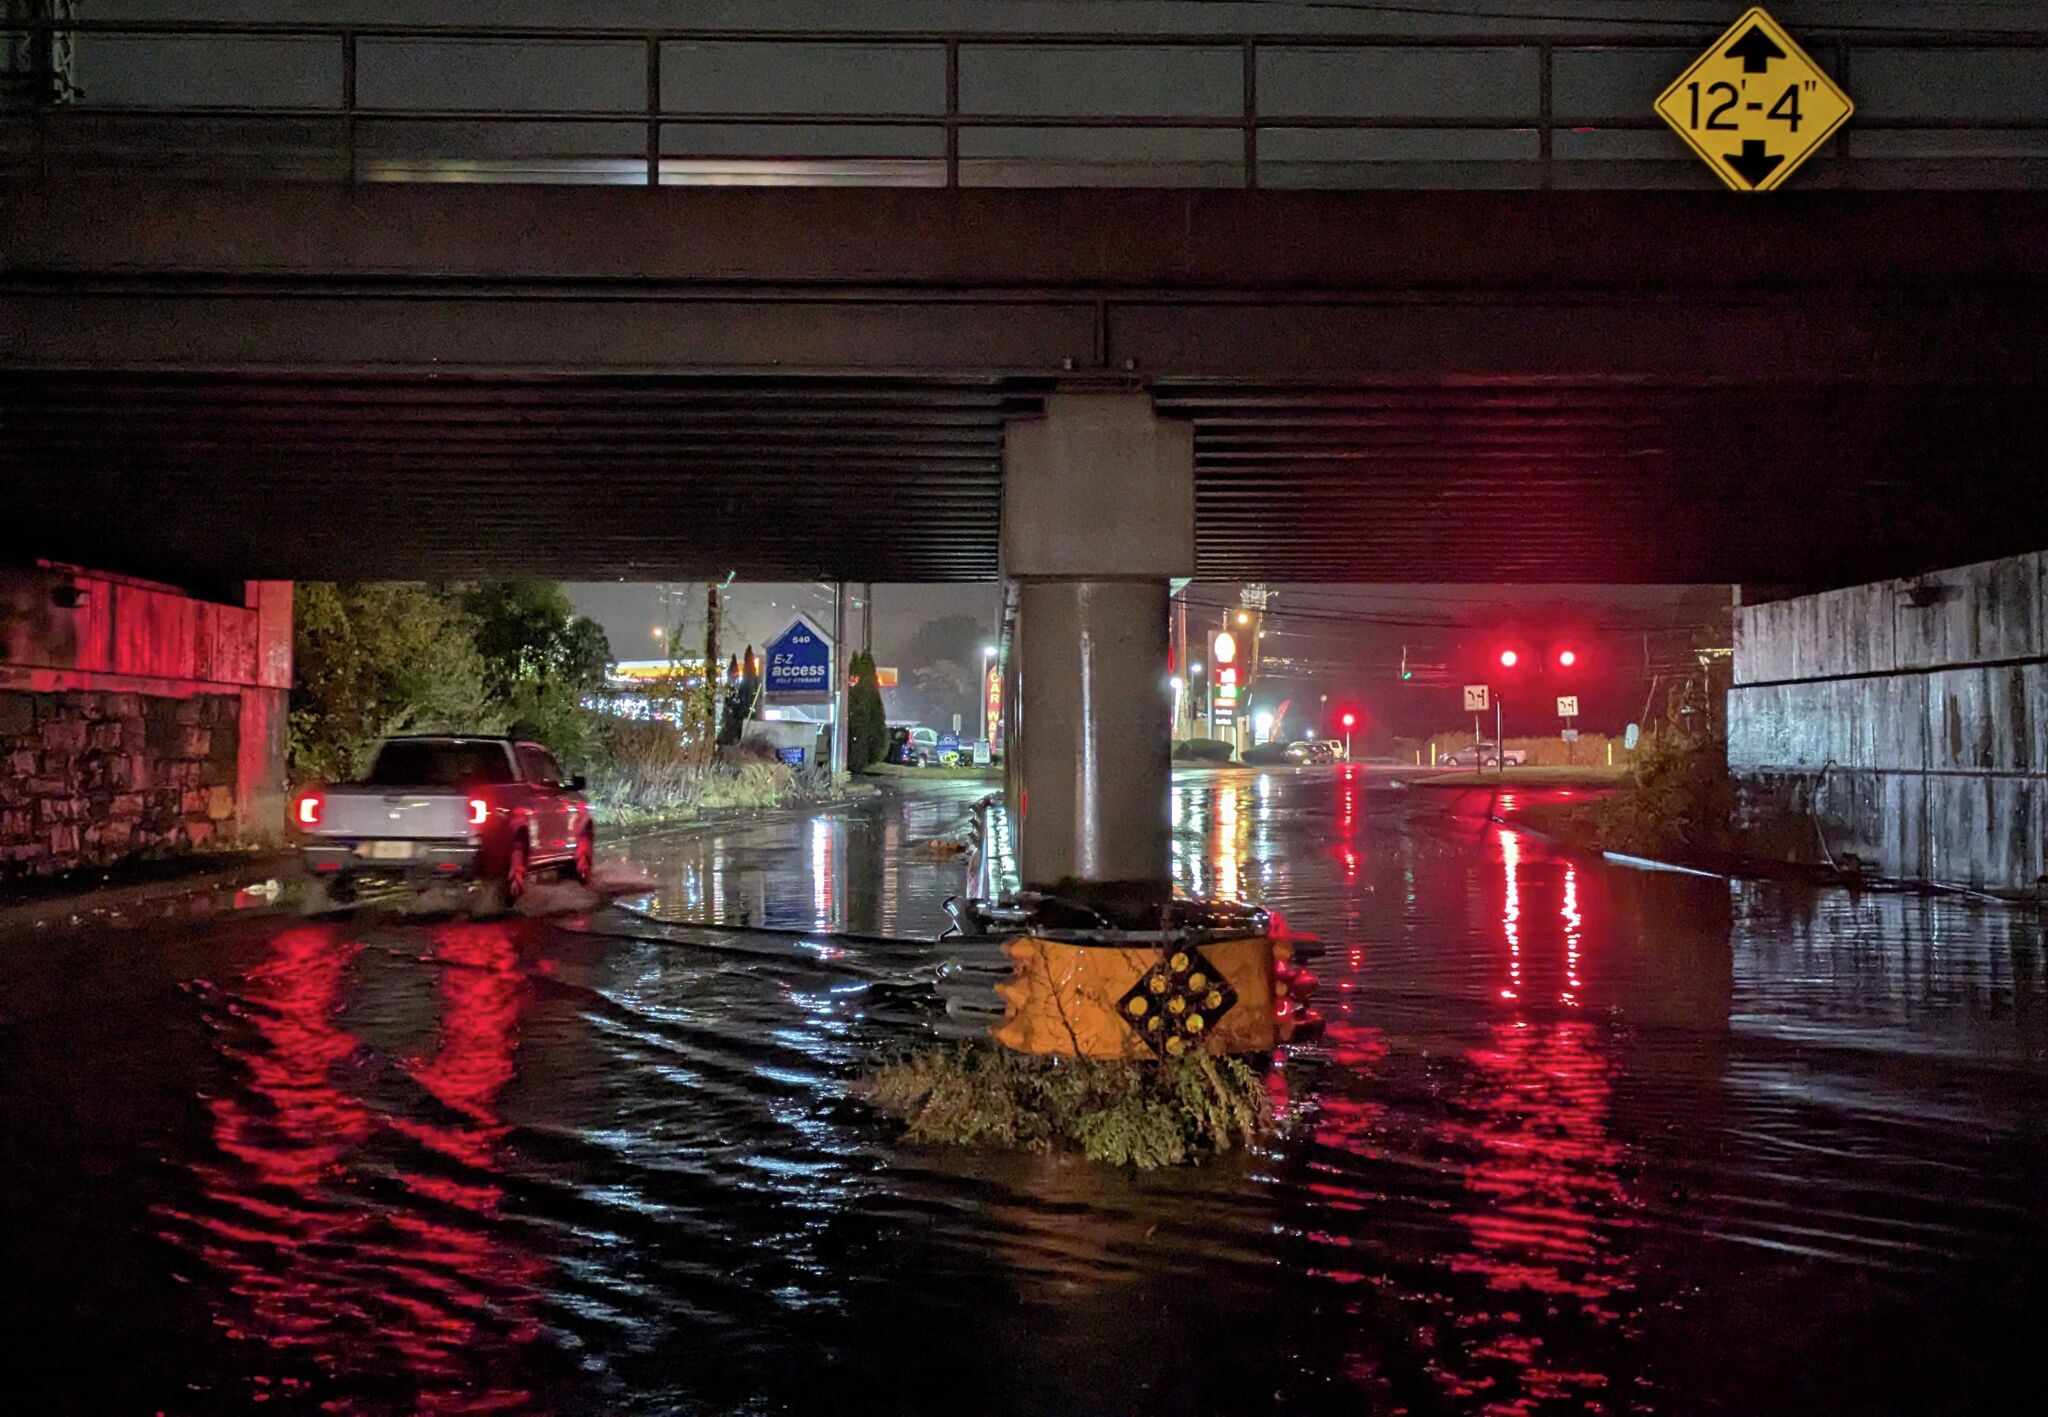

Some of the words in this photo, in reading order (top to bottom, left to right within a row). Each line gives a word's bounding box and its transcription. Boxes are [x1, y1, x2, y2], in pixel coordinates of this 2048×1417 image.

[1687, 79, 1817, 133] 12'-4"
[774, 654, 794, 664] E-Z
[772, 665, 825, 676] access
[990, 672, 1000, 704] CAR
